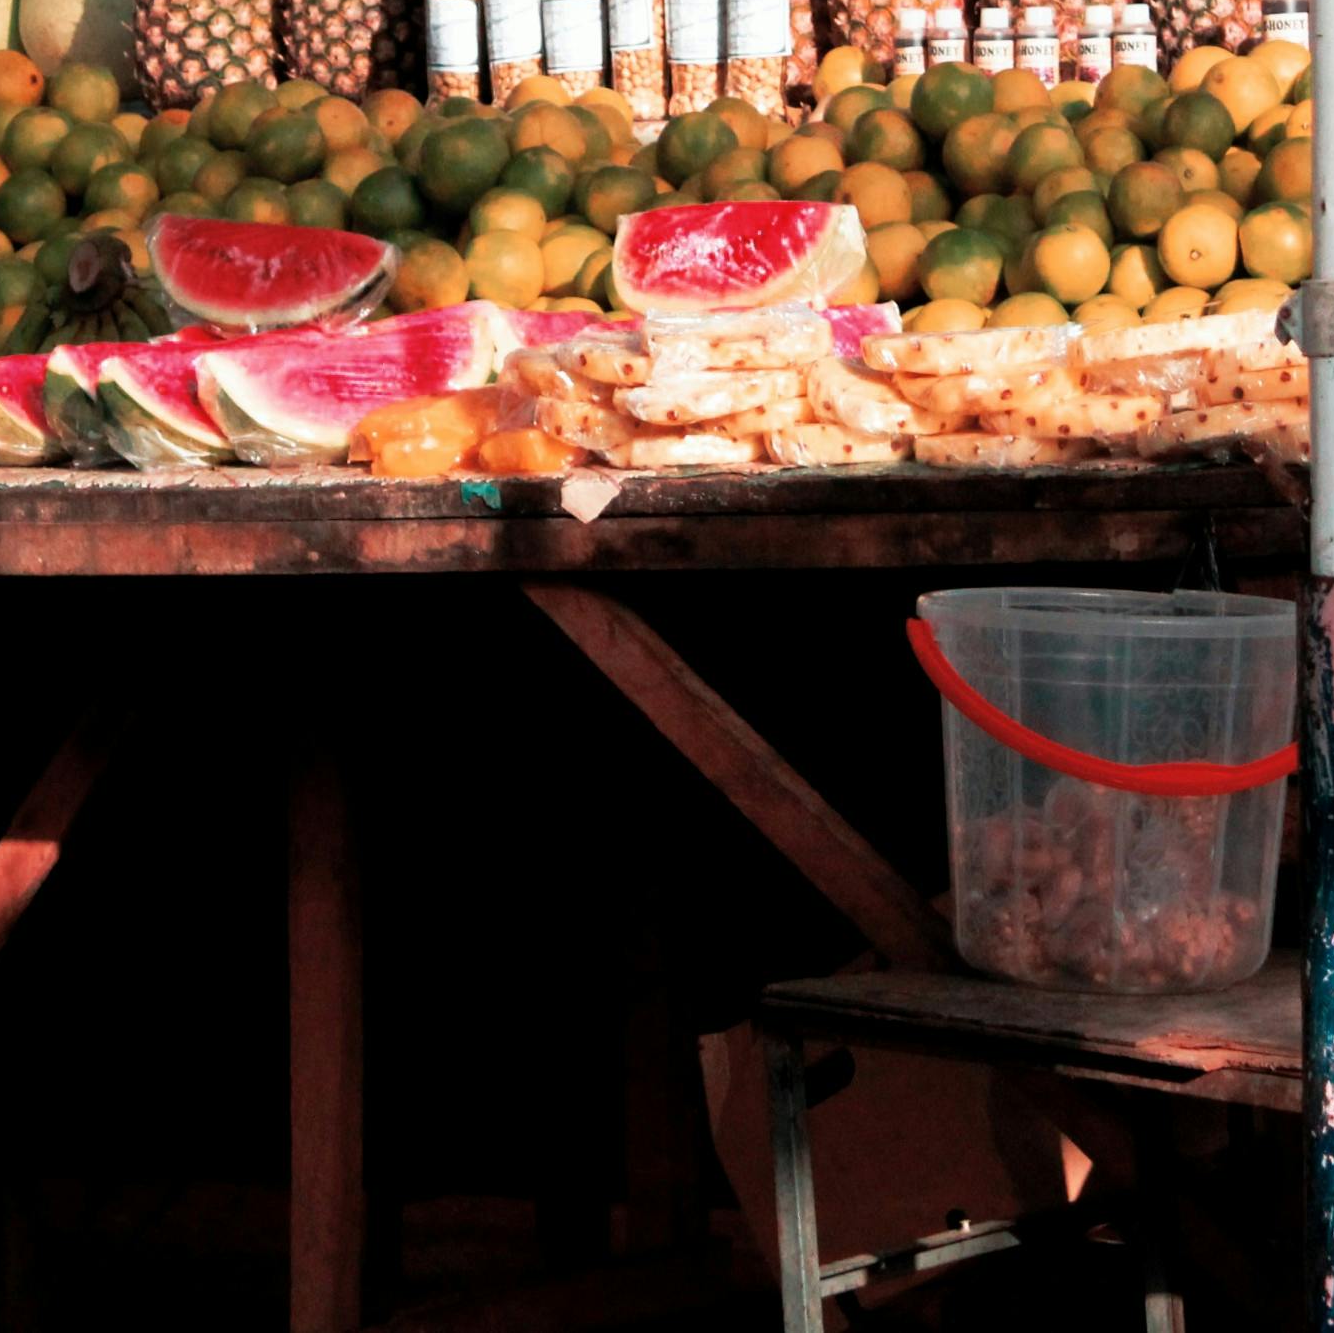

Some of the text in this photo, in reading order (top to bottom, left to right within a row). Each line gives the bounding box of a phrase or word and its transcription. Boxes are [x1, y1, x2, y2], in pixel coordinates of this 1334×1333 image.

[931, 46, 959, 57] ONEY
[1020, 45, 1055, 56] HONEY
[896, 53, 922, 63] ONEY
